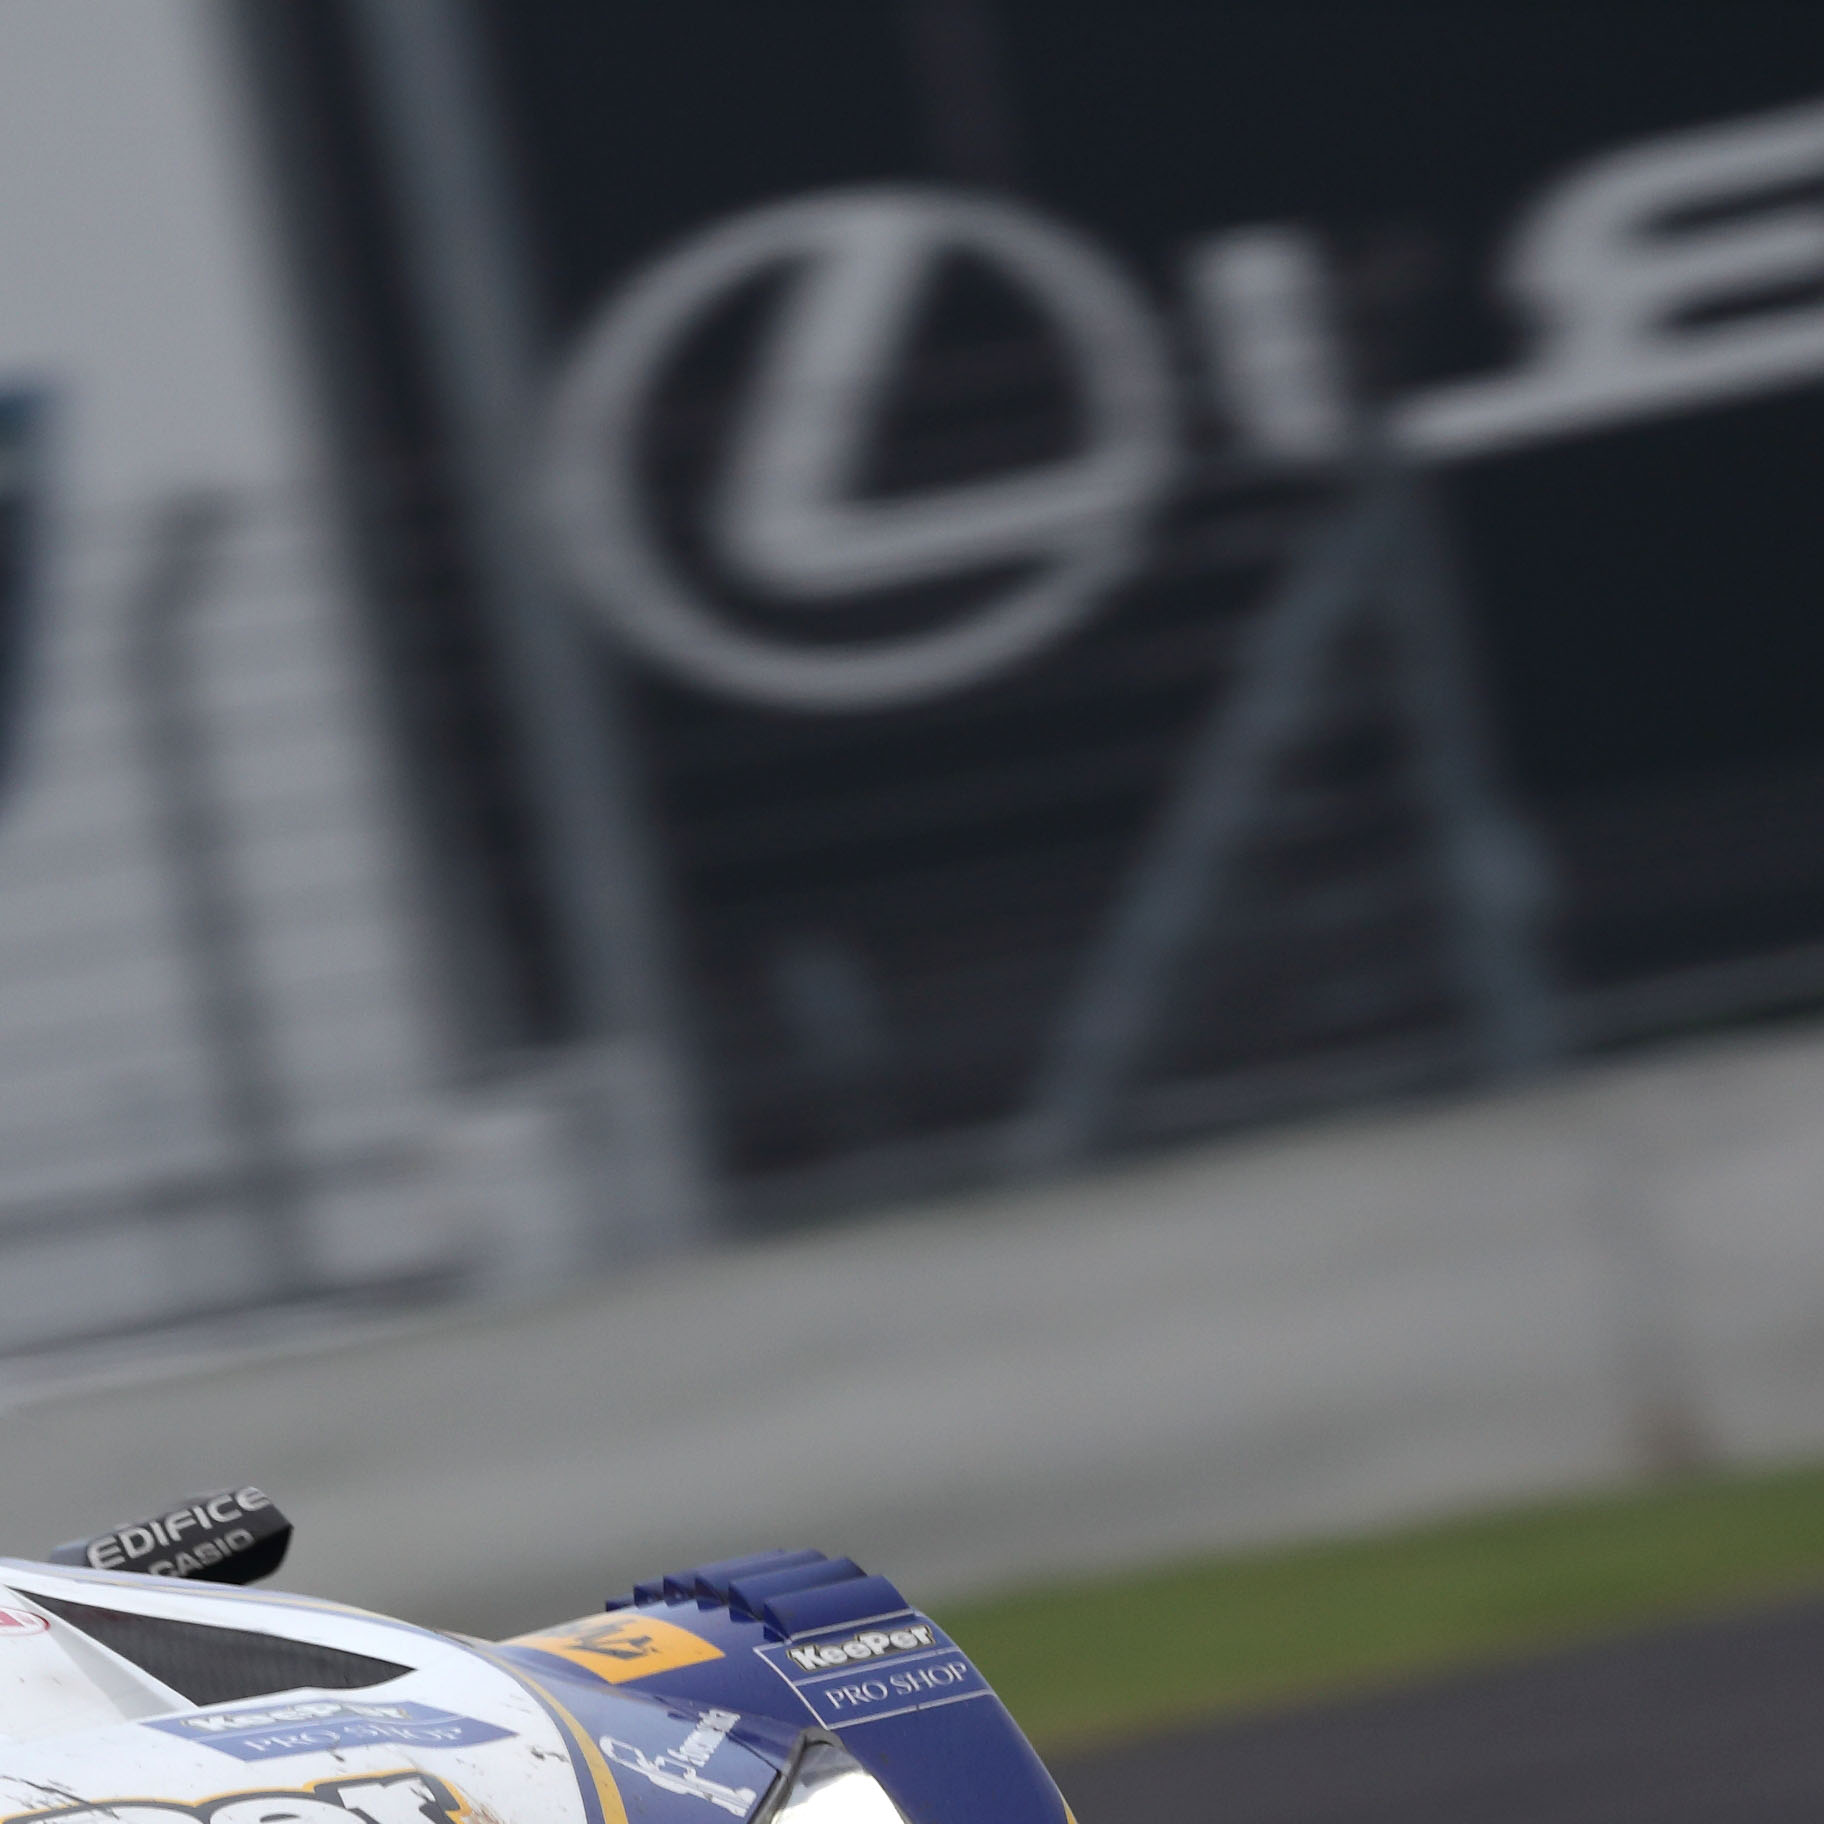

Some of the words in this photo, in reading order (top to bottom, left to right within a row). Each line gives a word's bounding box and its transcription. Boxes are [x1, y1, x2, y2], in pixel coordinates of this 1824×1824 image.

[86, 1485, 271, 1570] EDIFICE
[148, 1528, 255, 1577] CASIO
[786, 1623, 935, 1672] KeePer
[825, 1680, 889, 1712] PRO
[889, 1659, 969, 1696] SHOP
